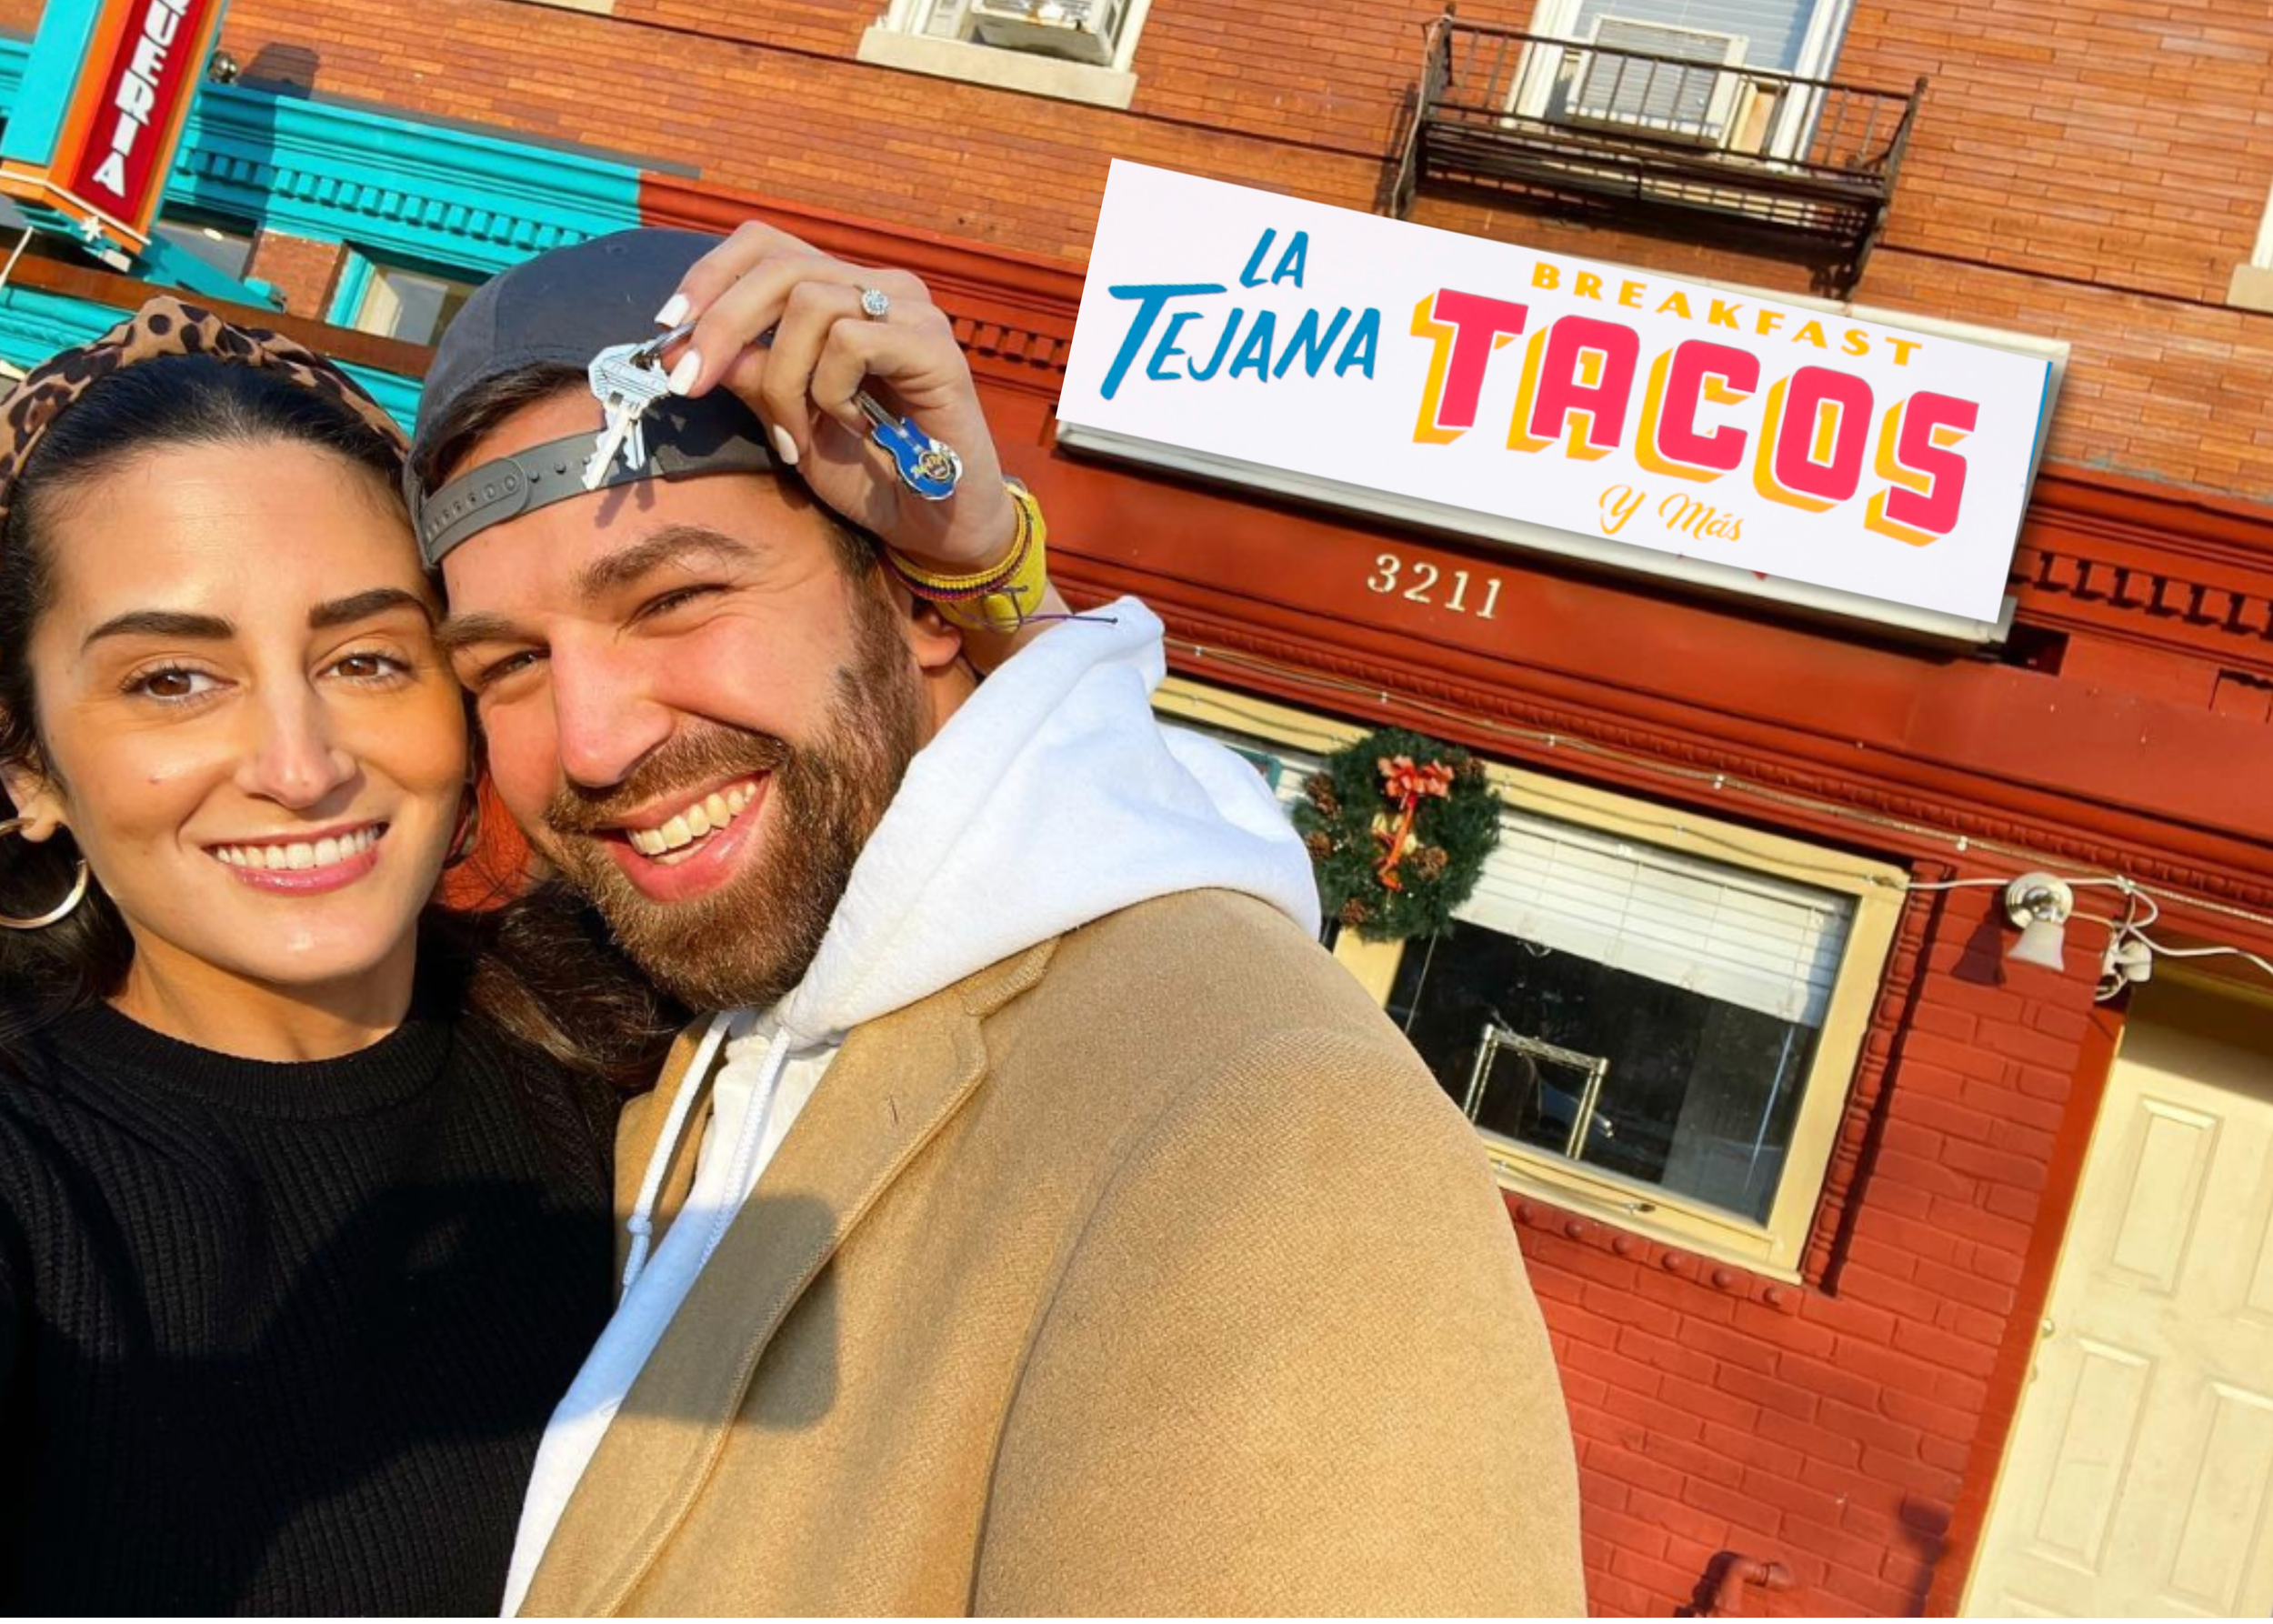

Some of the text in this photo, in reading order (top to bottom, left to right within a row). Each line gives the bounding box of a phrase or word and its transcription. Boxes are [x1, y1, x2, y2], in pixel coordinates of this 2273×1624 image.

[93, 0, 190, 196] UERIA
[1239, 227, 1308, 288] LA
[1099, 283, 1381, 400] TEJANA
[1531, 261, 1923, 366] BREAKFAST
[1409, 288, 1979, 547] TACOS
[1657, 492, 1744, 542] Más
[1367, 553, 1502, 619] 3211
